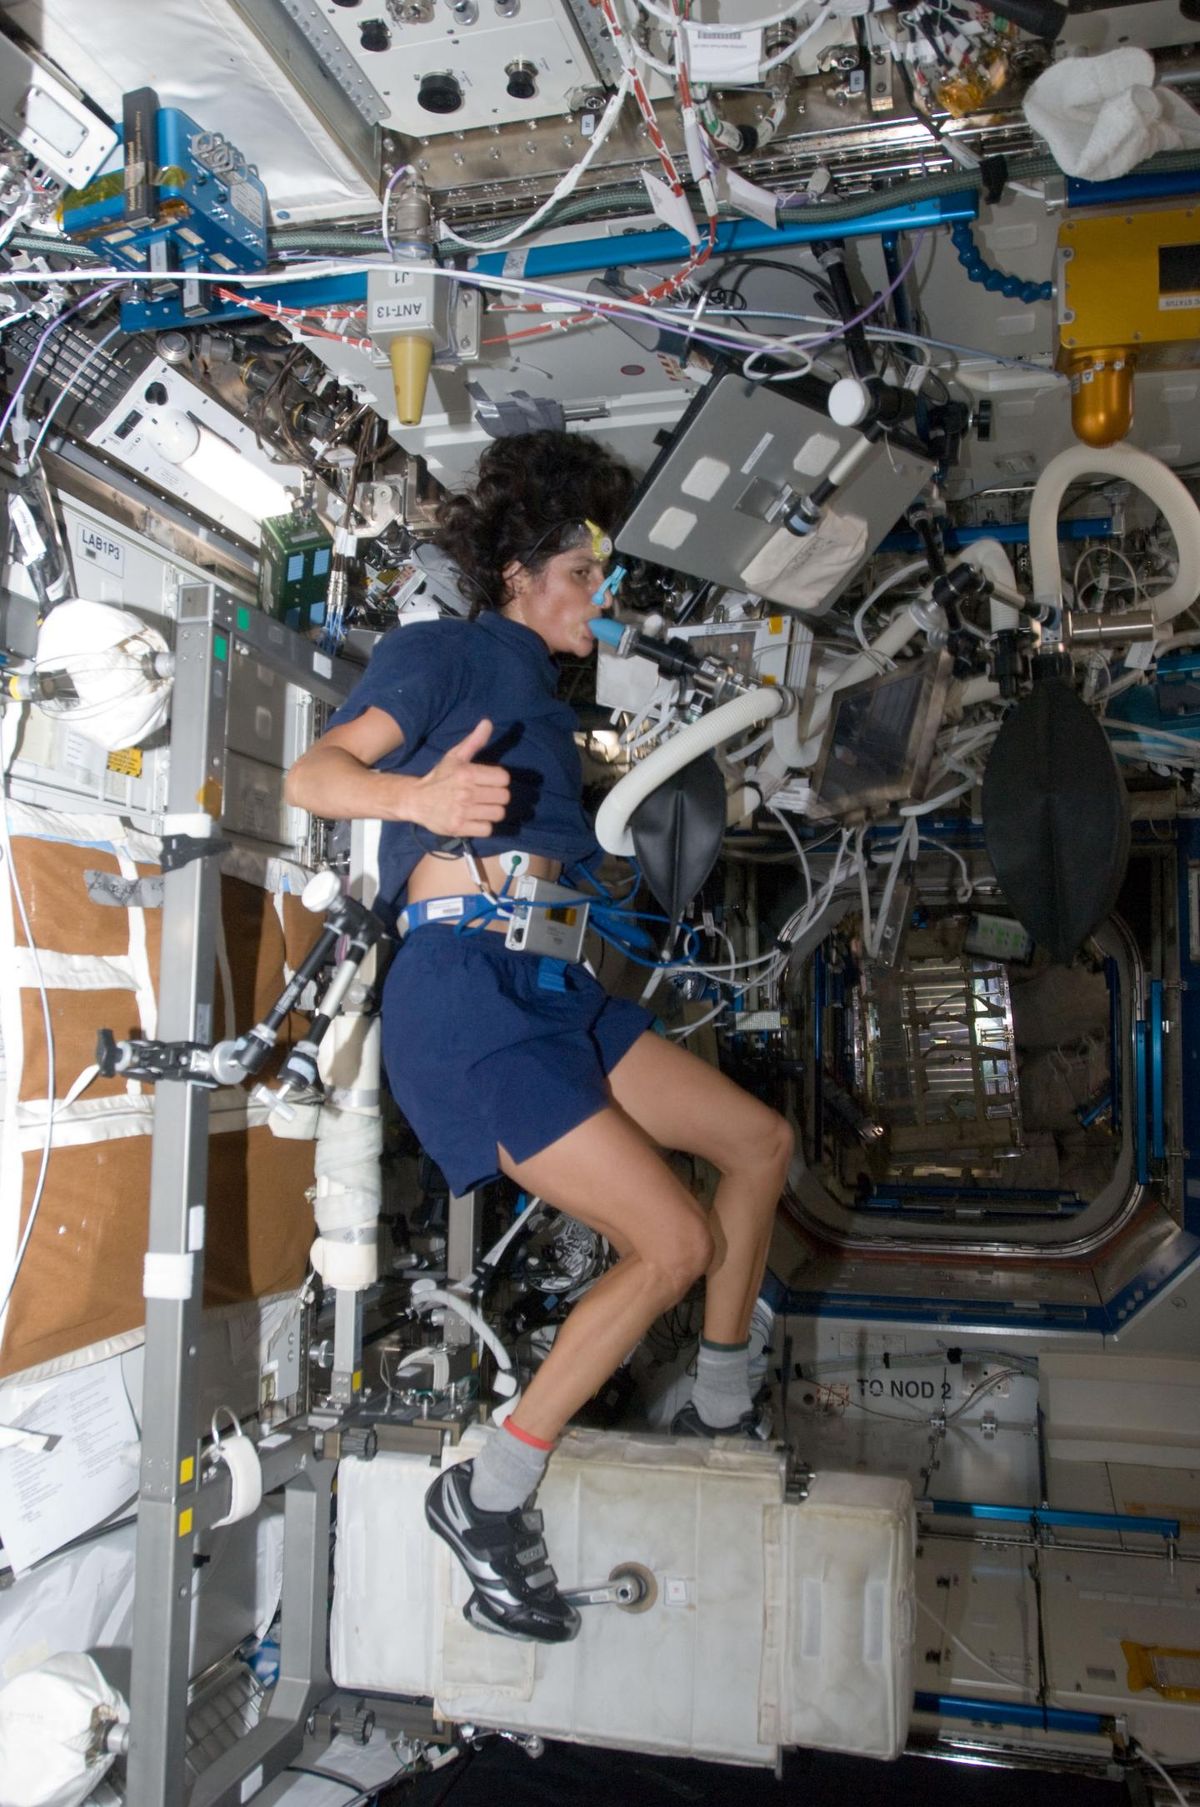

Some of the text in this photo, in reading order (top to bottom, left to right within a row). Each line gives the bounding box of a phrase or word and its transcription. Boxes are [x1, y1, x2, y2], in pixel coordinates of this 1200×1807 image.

[394, 271, 410, 284] J1
[376, 302, 422, 318] ANT-13
[82, 529, 120, 560] LAB1P3
[856, 1379, 884, 1397] TO
[890, 1380, 934, 1399] NOD
[941, 1382, 952, 1399] 2
